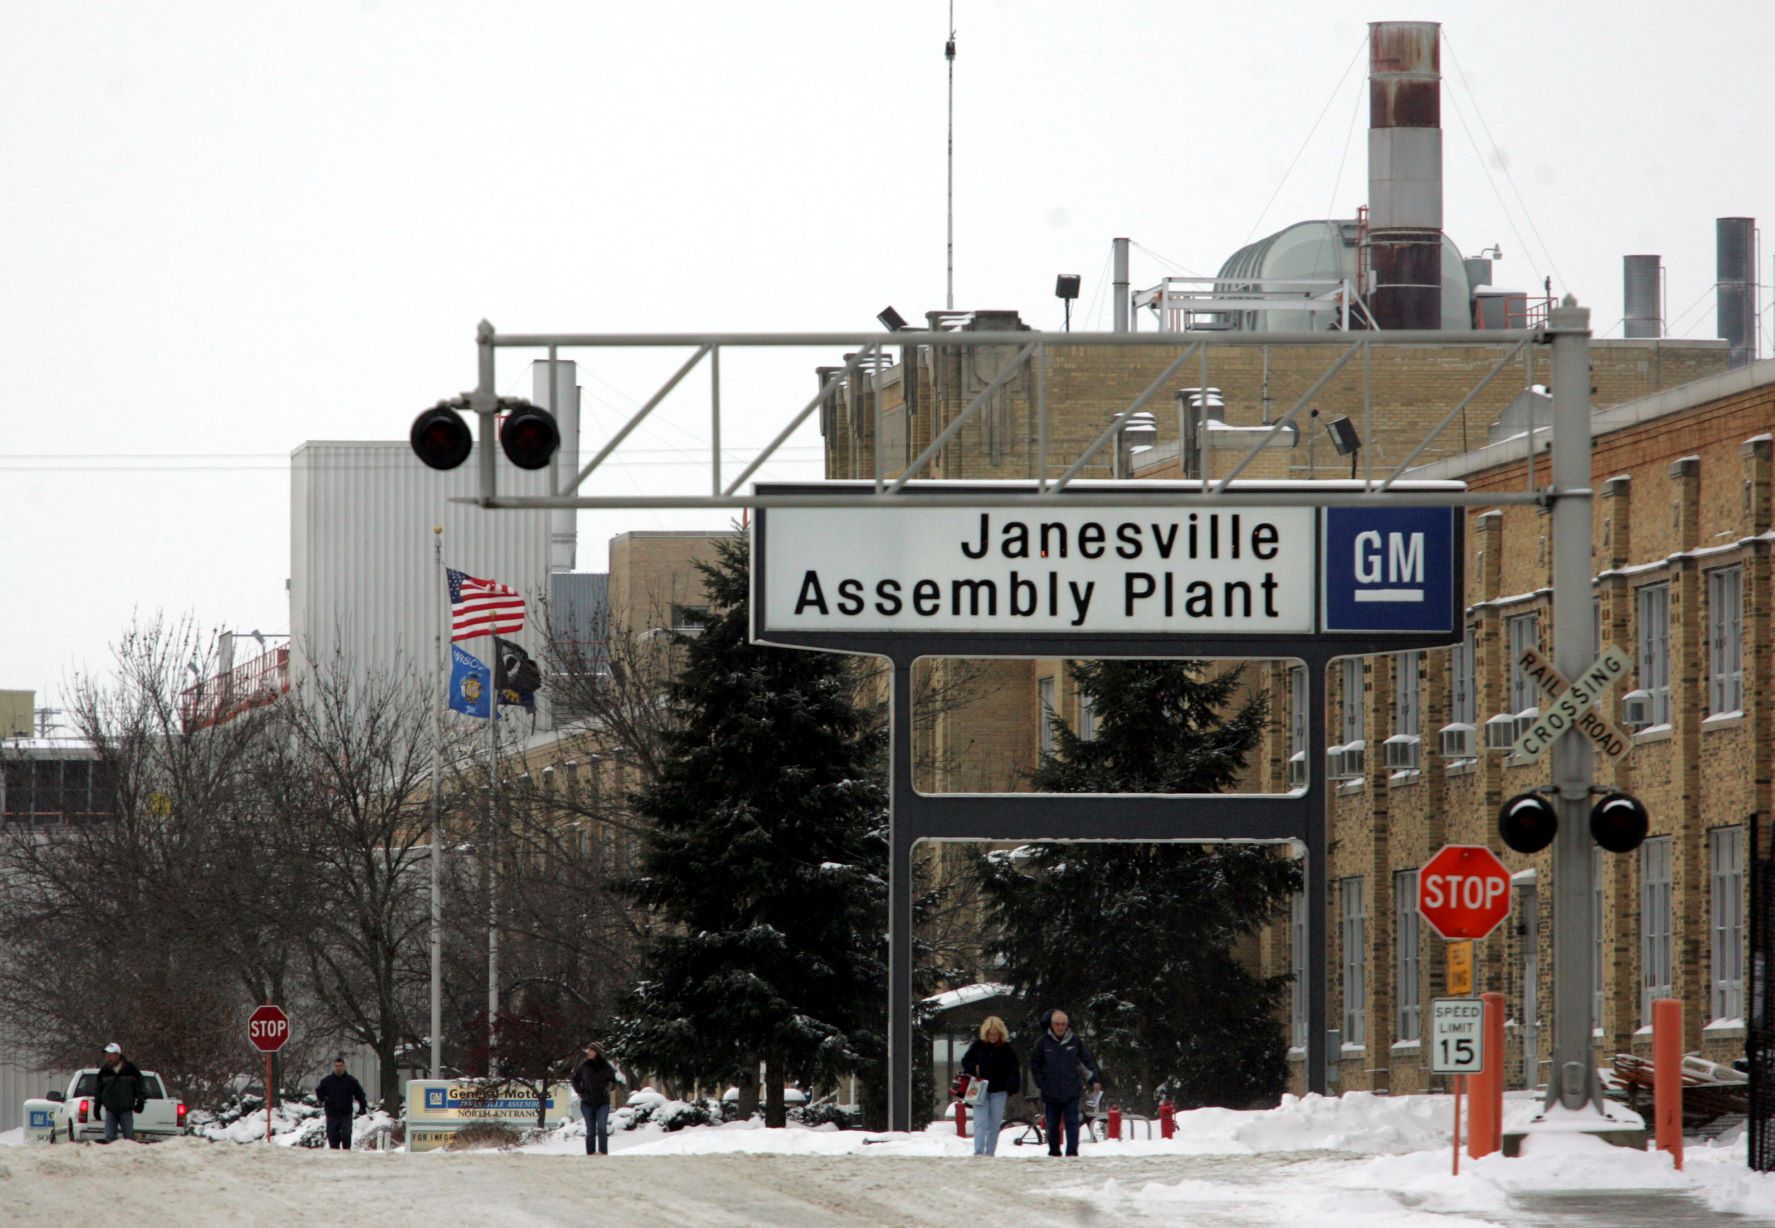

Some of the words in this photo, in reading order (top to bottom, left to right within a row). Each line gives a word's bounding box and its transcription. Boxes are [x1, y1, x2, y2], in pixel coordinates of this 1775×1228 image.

[960, 512, 1280, 561] Janesville
[1353, 530, 1425, 583] GM
[793, 570, 1096, 627] Assembly
[1124, 571, 1279, 618] Plant
[1518, 652, 1561, 699] RAIL
[1522, 656, 1621, 755] CROSSING
[1580, 713, 1623, 757] ROAD
[1424, 874, 1505, 909] STOP
[250, 1020, 286, 1037] STOP
[1436, 1006, 1480, 1018] SPEED
[1440, 1022, 1474, 1034] LIMIT
[1440, 1039, 1474, 1065] 15
[429, 1092, 443, 1105] GM
[505, 1088, 552, 1099] Motos
